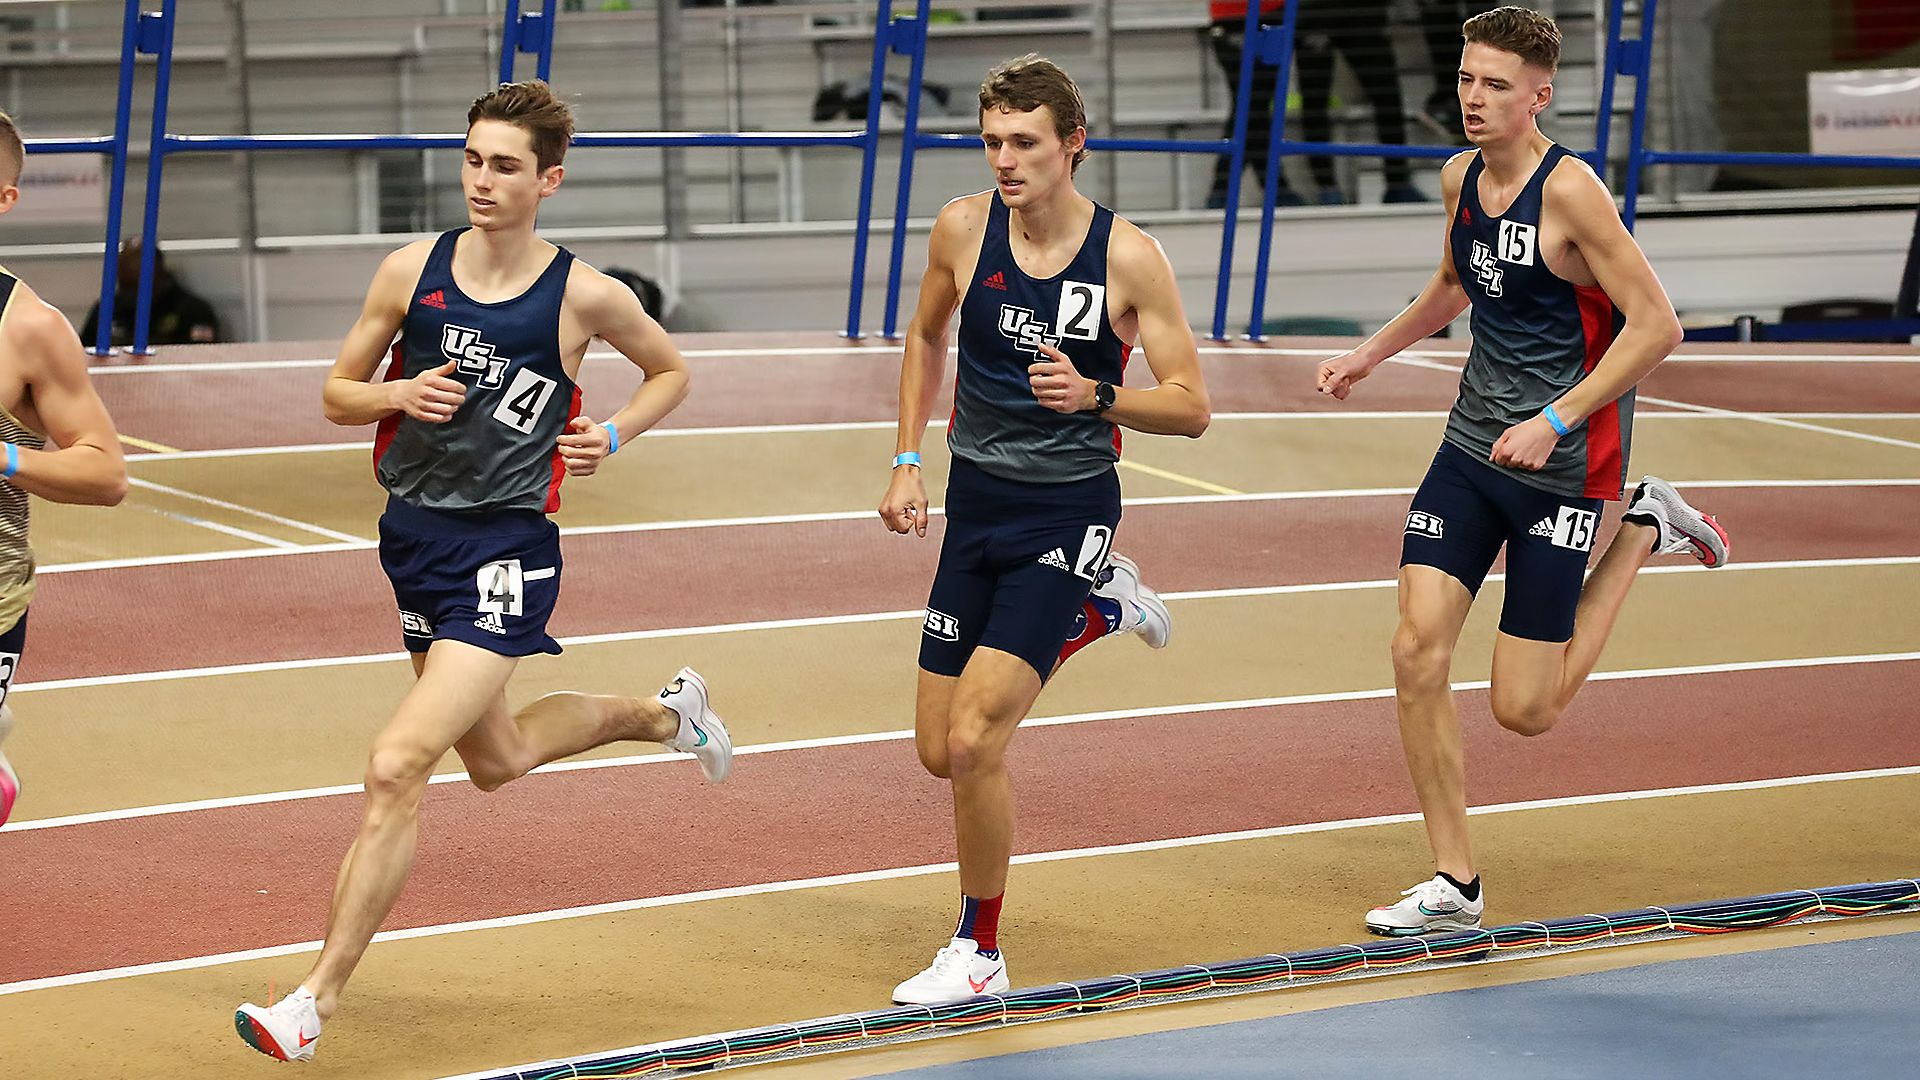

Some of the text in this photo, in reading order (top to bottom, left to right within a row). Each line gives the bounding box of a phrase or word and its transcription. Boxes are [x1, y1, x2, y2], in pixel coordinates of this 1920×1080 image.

[1504, 223, 1526, 262] 15
[1471, 241, 1502, 295] USI
[1064, 286, 1093, 337] 2
[442, 324, 509, 389] USI
[507, 379, 547, 428] 4
[1405, 511, 1442, 538] SI
[1528, 527, 1555, 538] adida
[1566, 511, 1593, 549] 15
[1037, 556, 1071, 572] adidas
[1081, 528, 1107, 578] 2
[487, 563, 515, 613] 4
[400, 611, 433, 637] SI
[473, 620, 507, 636] adidas
[923, 608, 958, 640] SI
